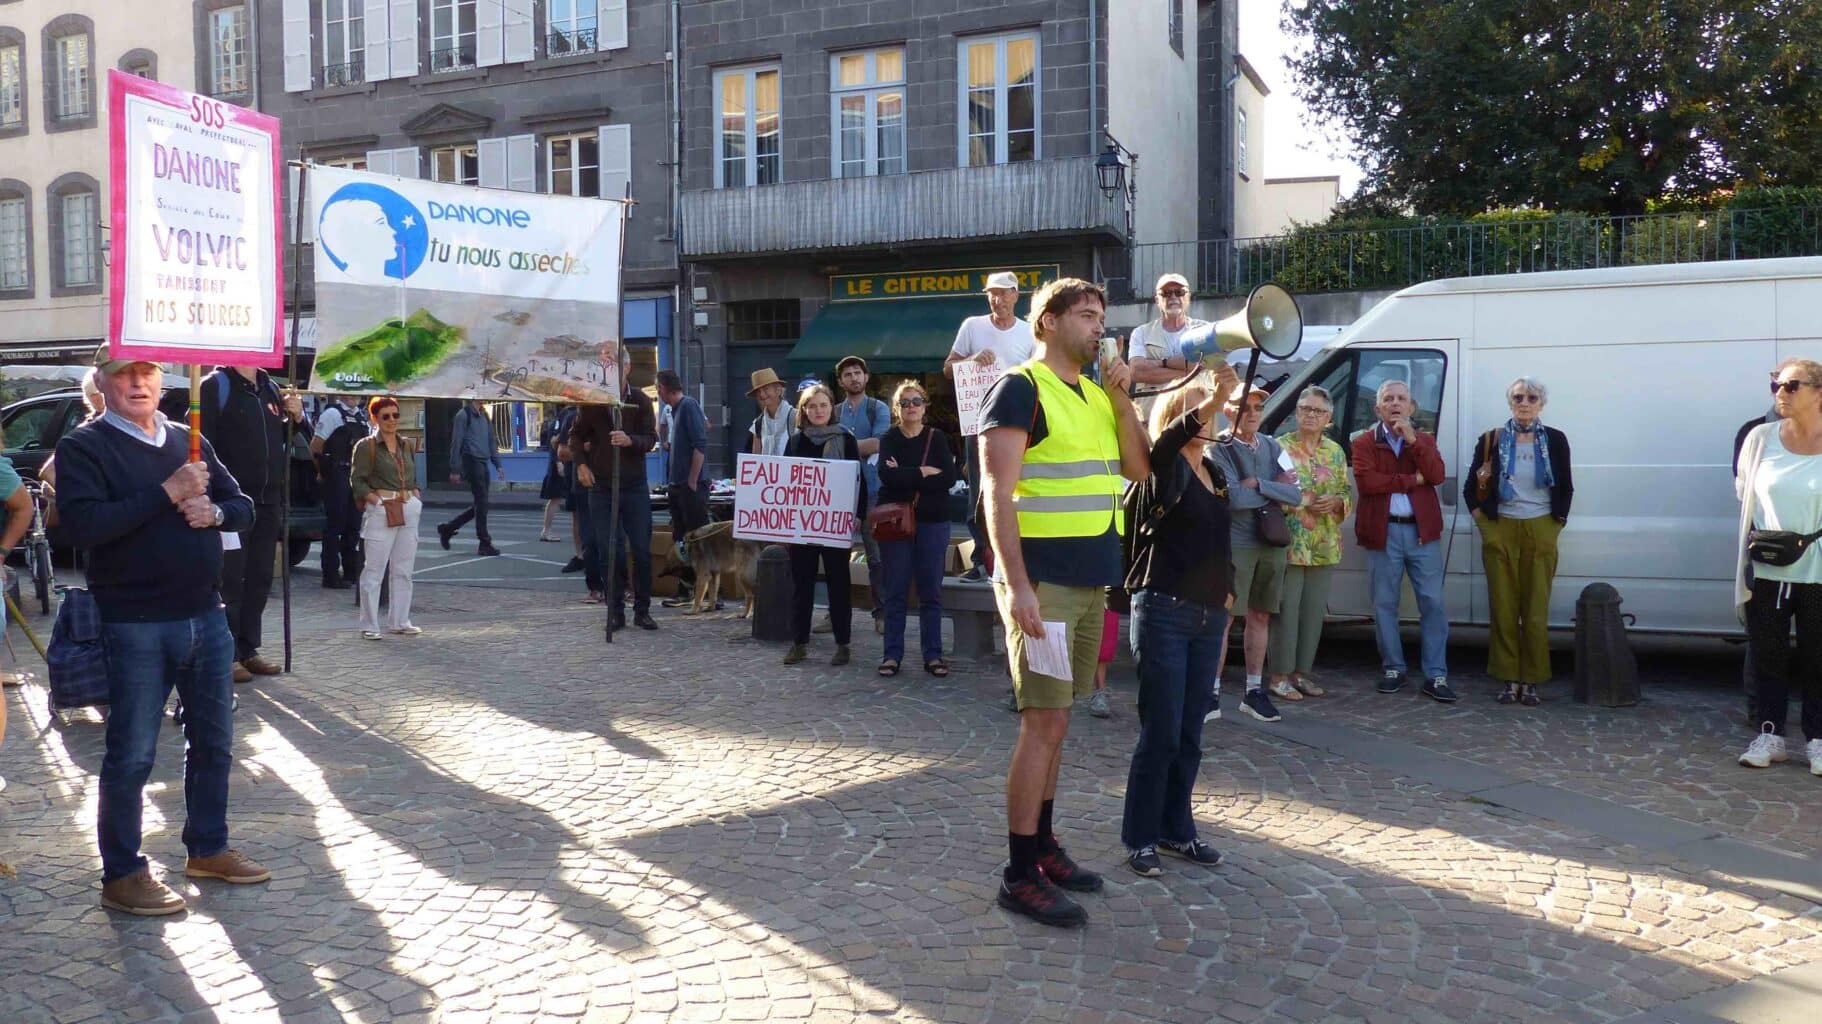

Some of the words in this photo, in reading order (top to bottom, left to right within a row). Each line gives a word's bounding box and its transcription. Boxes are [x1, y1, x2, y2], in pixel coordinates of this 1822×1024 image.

[191, 95, 224, 129] SOS
[154, 143, 241, 193] DANONE
[152, 223, 247, 270] VOLVIC
[430, 237, 451, 263] tu
[456, 245, 501, 268] nous
[847, 278, 872, 295] LE
[884, 274, 969, 294] CITRON
[980, 271, 1041, 289] VRT
[145, 299, 177, 323] NOS
[187, 302, 252, 326] SOURCES
[957, 378, 968, 388] LA
[741, 461, 779, 485] EAU
[761, 486, 831, 506] COMMUN
[738, 508, 797, 530] DANONE
